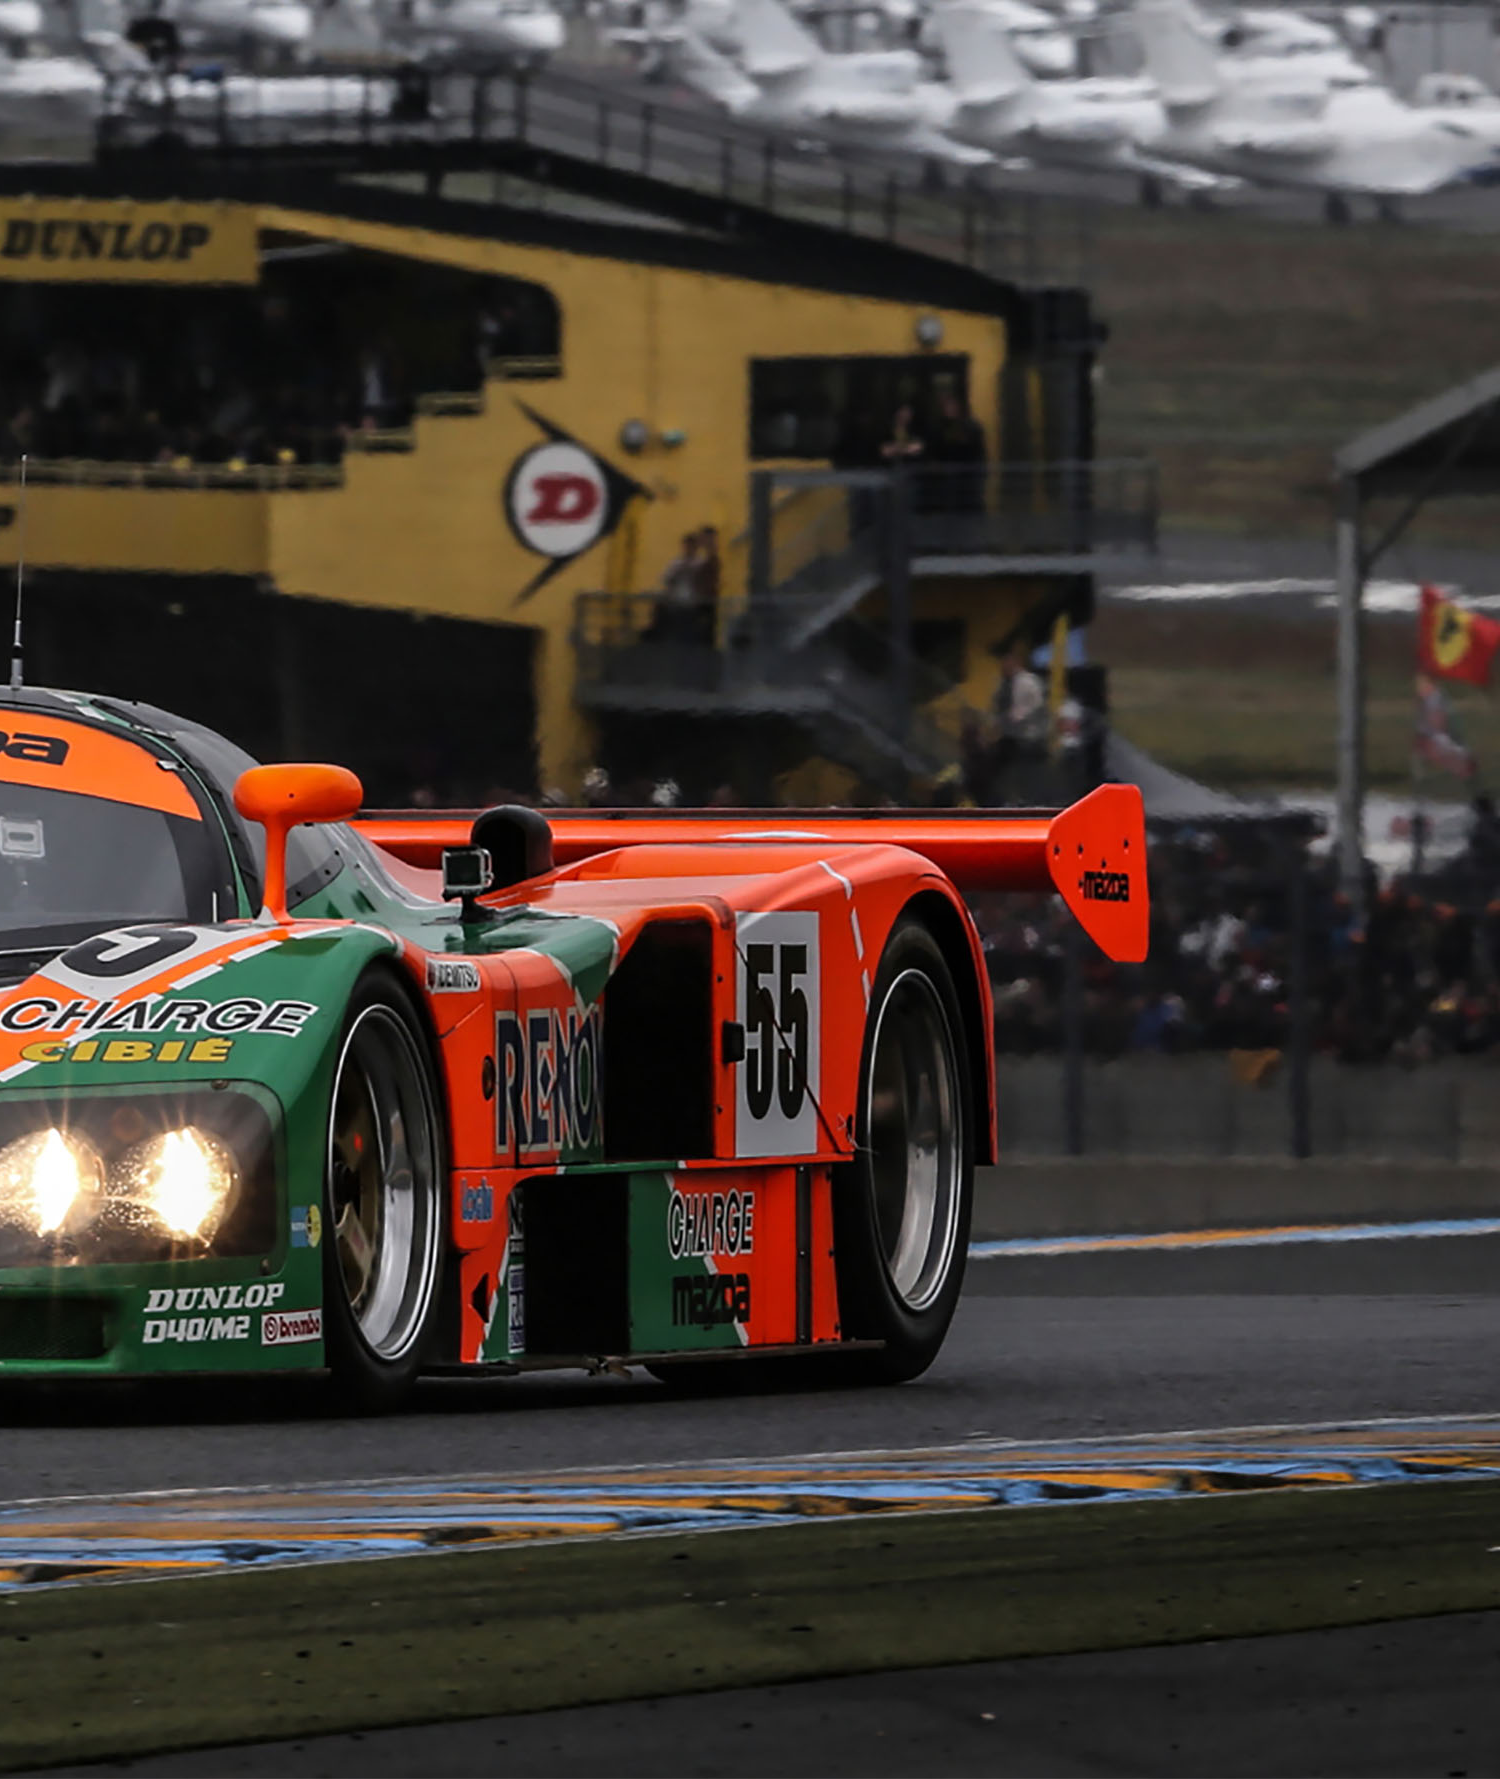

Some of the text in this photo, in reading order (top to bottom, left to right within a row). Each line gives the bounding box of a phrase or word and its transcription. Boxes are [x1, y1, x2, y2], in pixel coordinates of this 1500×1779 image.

[0, 218, 211, 262] DUNLOP
[526, 472, 600, 525] D
[1084, 871, 1130, 902] mazda
[0, 997, 318, 1038] CHARGE
[746, 943, 808, 1120] 55
[19, 1037, 235, 1064] CIBIÉ
[667, 1188, 755, 1260] CHARGE
[143, 1283, 285, 1312] DUNLOP
[672, 1273, 750, 1326] mazda
[142, 1315, 251, 1343] D40/M2
[279, 1313, 321, 1338] brembo
